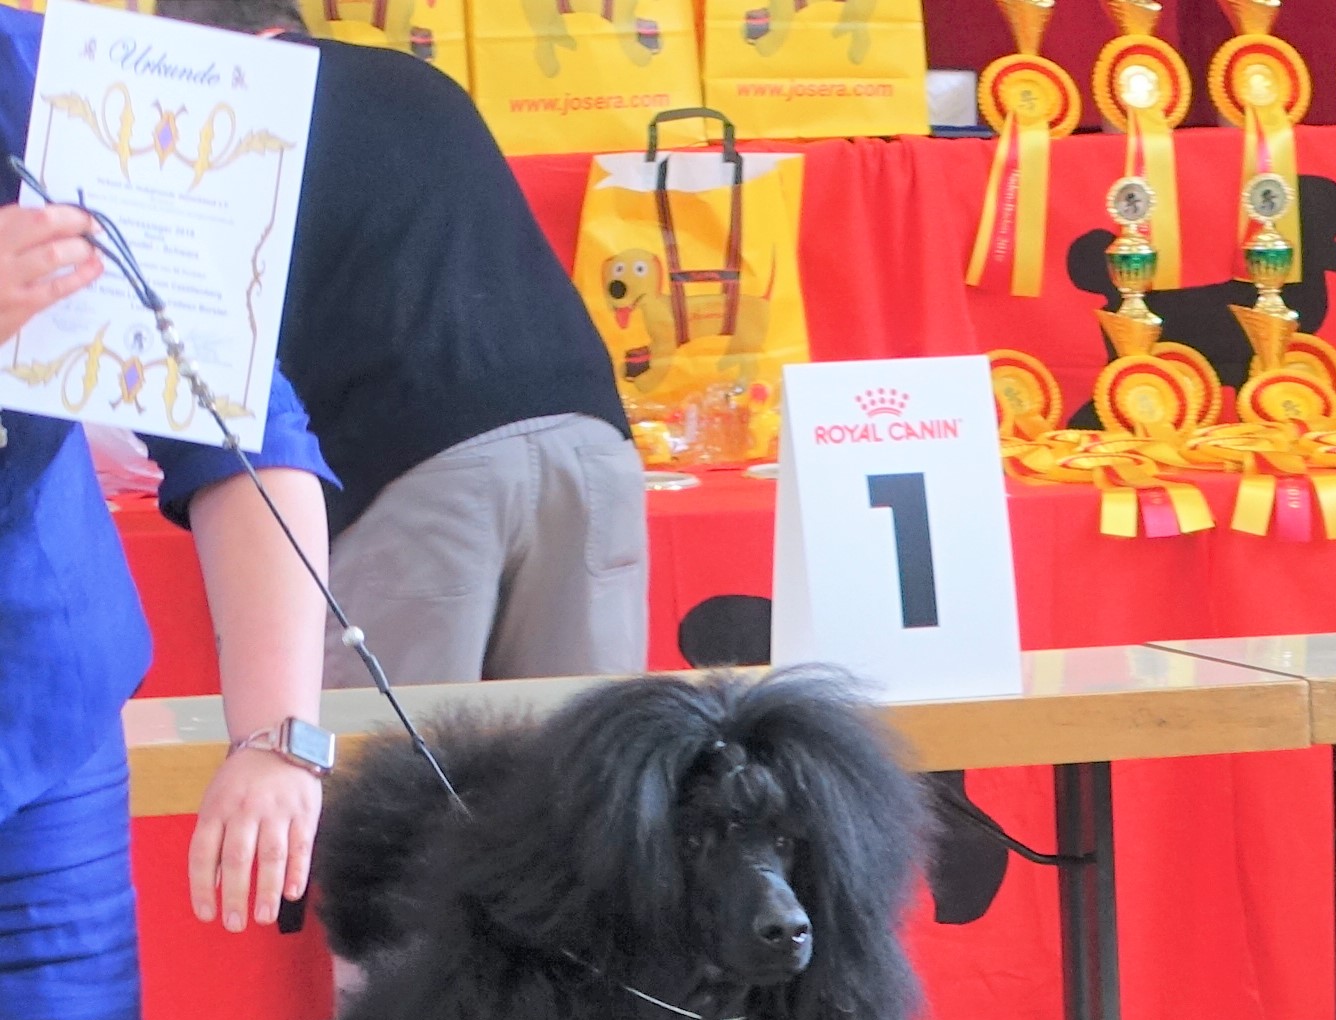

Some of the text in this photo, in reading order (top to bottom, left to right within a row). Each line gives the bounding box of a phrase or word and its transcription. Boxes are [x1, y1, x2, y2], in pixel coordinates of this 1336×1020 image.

[109, 37, 221, 86] Urkunde
[736, 79, 893, 102] www.josera.com
[510, 93, 670, 116] www.josera.com
[814, 418, 960, 445] ROYAL CANIN
[866, 472, 940, 629] 1
